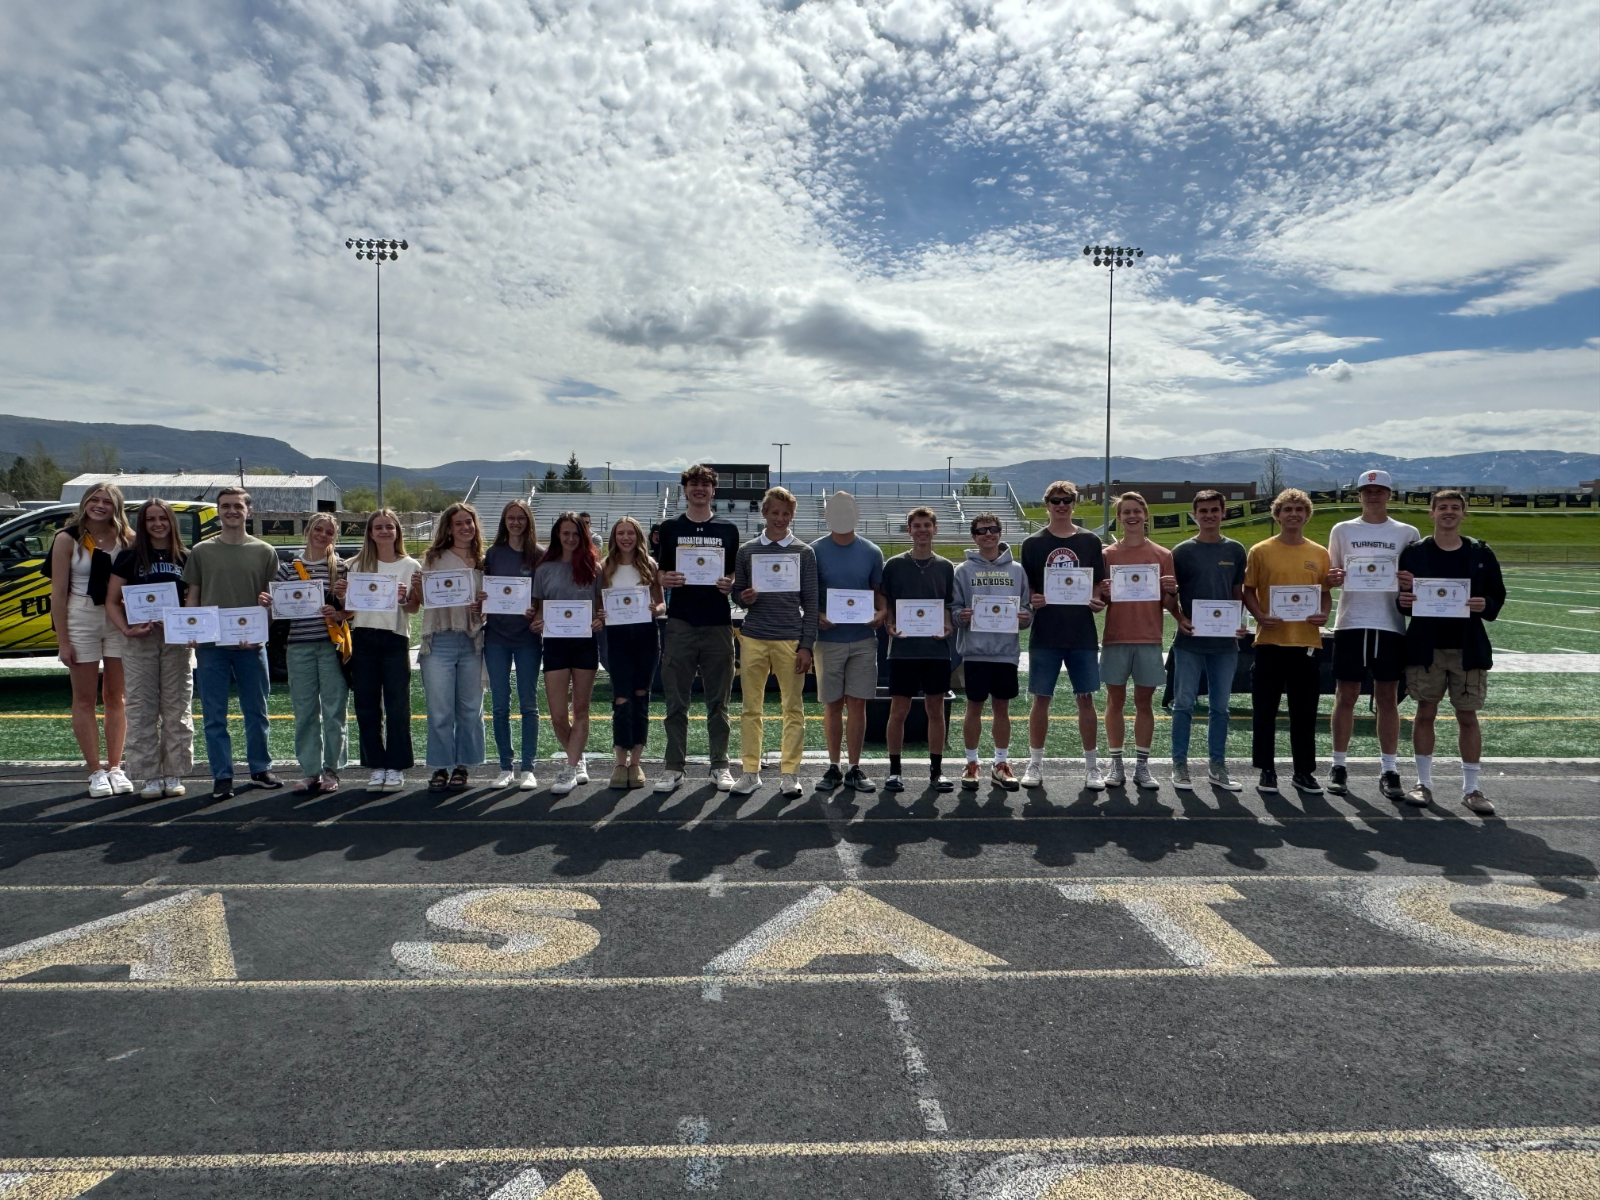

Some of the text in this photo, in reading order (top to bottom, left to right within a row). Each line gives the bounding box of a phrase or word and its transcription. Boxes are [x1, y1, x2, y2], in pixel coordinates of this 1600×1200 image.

[678, 536, 722, 546] WASATCH WASPS
[1351, 541, 1396, 550] TURNSTILE
[139, 563, 158, 577] SN
[971, 578, 1014, 587] LACROSSE
